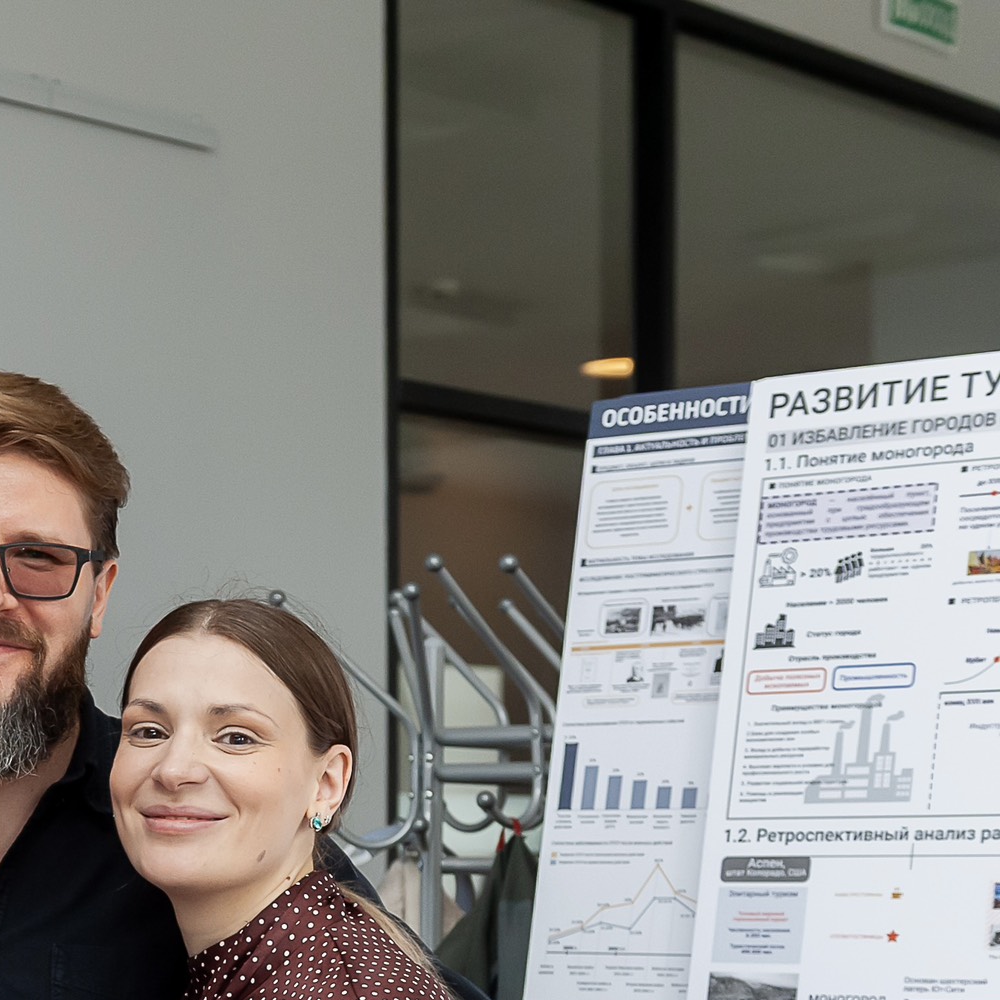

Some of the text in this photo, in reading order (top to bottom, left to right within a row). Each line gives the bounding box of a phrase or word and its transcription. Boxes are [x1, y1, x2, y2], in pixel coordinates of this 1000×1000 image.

[769, 375, 950, 418] РАЗВИТИЕ
[768, 412, 996, 448] 01 ИЗБАВЛЕНИЕ ГОРОДОВ
[797, 451, 867, 469] Понятие
[871, 442, 974, 461] моногорода
[725, 829, 751, 843] 1.2.
[756, 823, 909, 845] Ретроспективный
[914, 827, 976, 841] анализ
